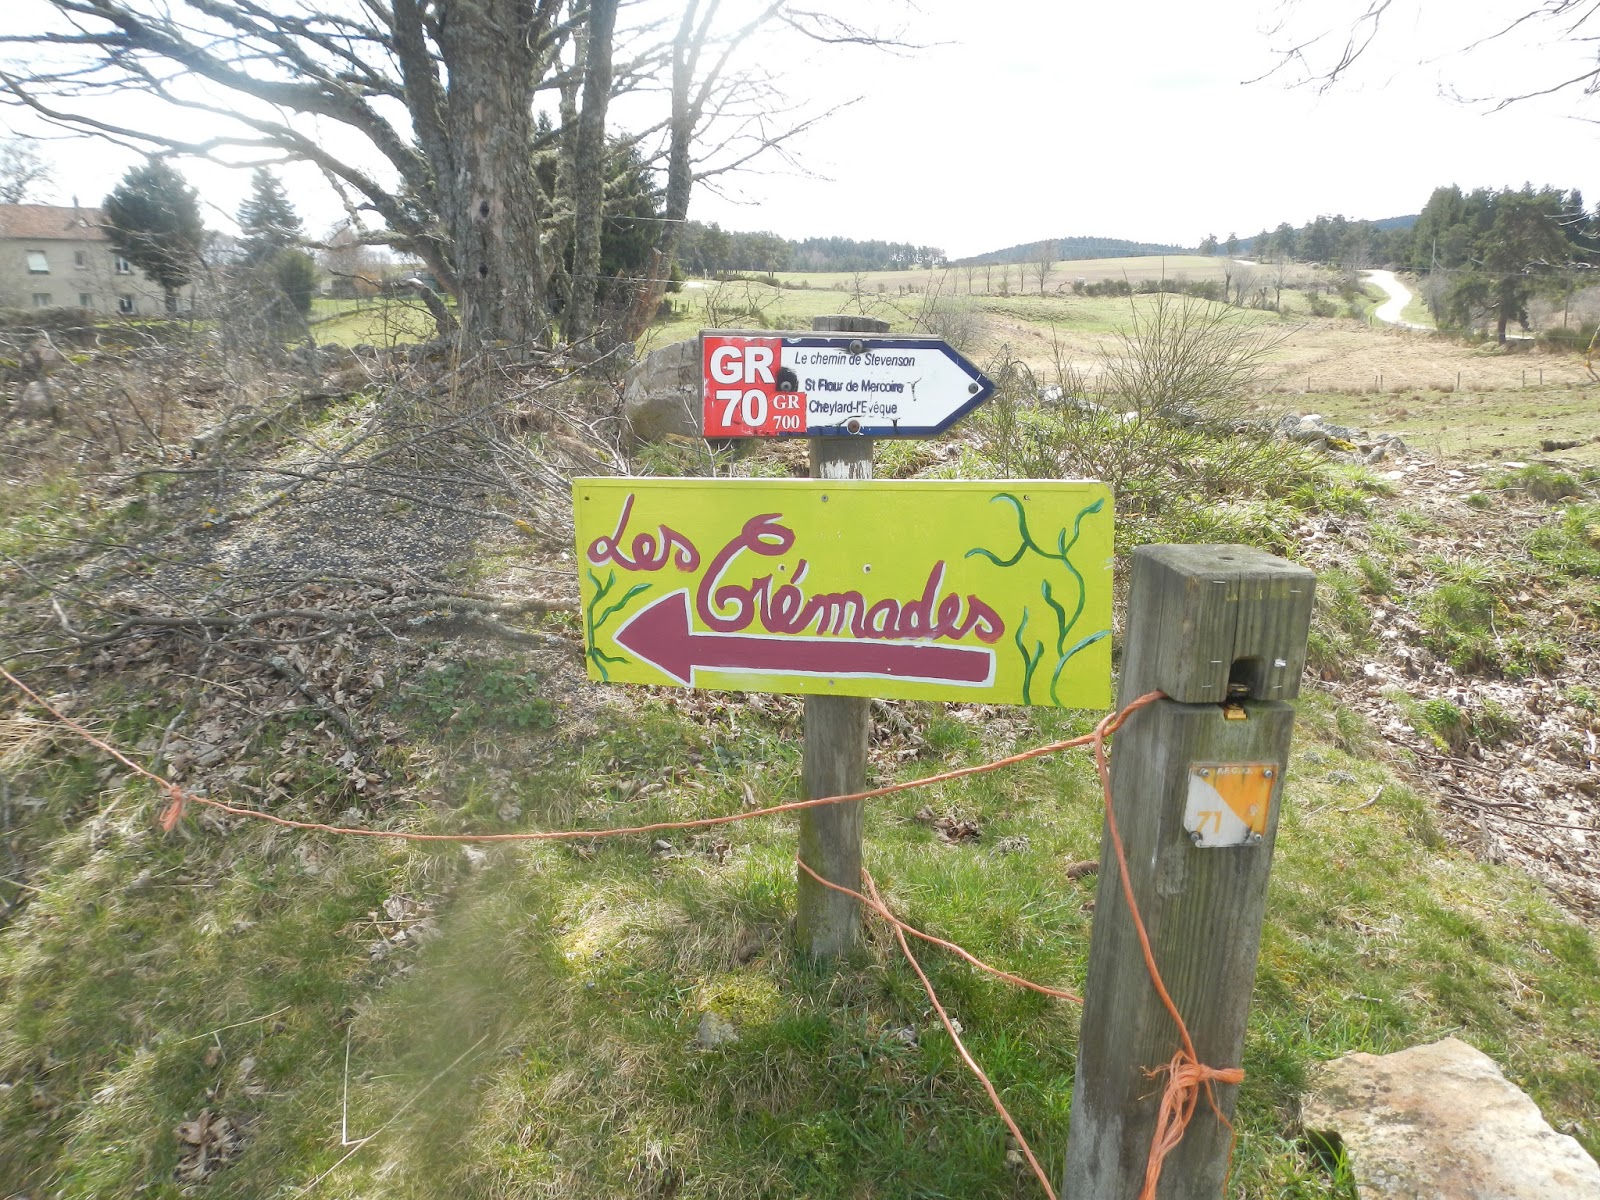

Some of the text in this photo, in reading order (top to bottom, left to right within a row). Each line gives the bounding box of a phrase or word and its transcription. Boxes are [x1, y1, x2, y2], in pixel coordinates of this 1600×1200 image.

[710, 345, 776, 385] GR
[794, 352, 915, 367] Le chemin de Stevenson
[804, 378, 816, 391] St
[846, 379, 859, 392] de
[715, 389, 769, 427] 70
[772, 394, 801, 410] GR
[772, 414, 801, 430] 700
[586, 493, 701, 574] Les
[1196, 811, 1222, 833] 71
